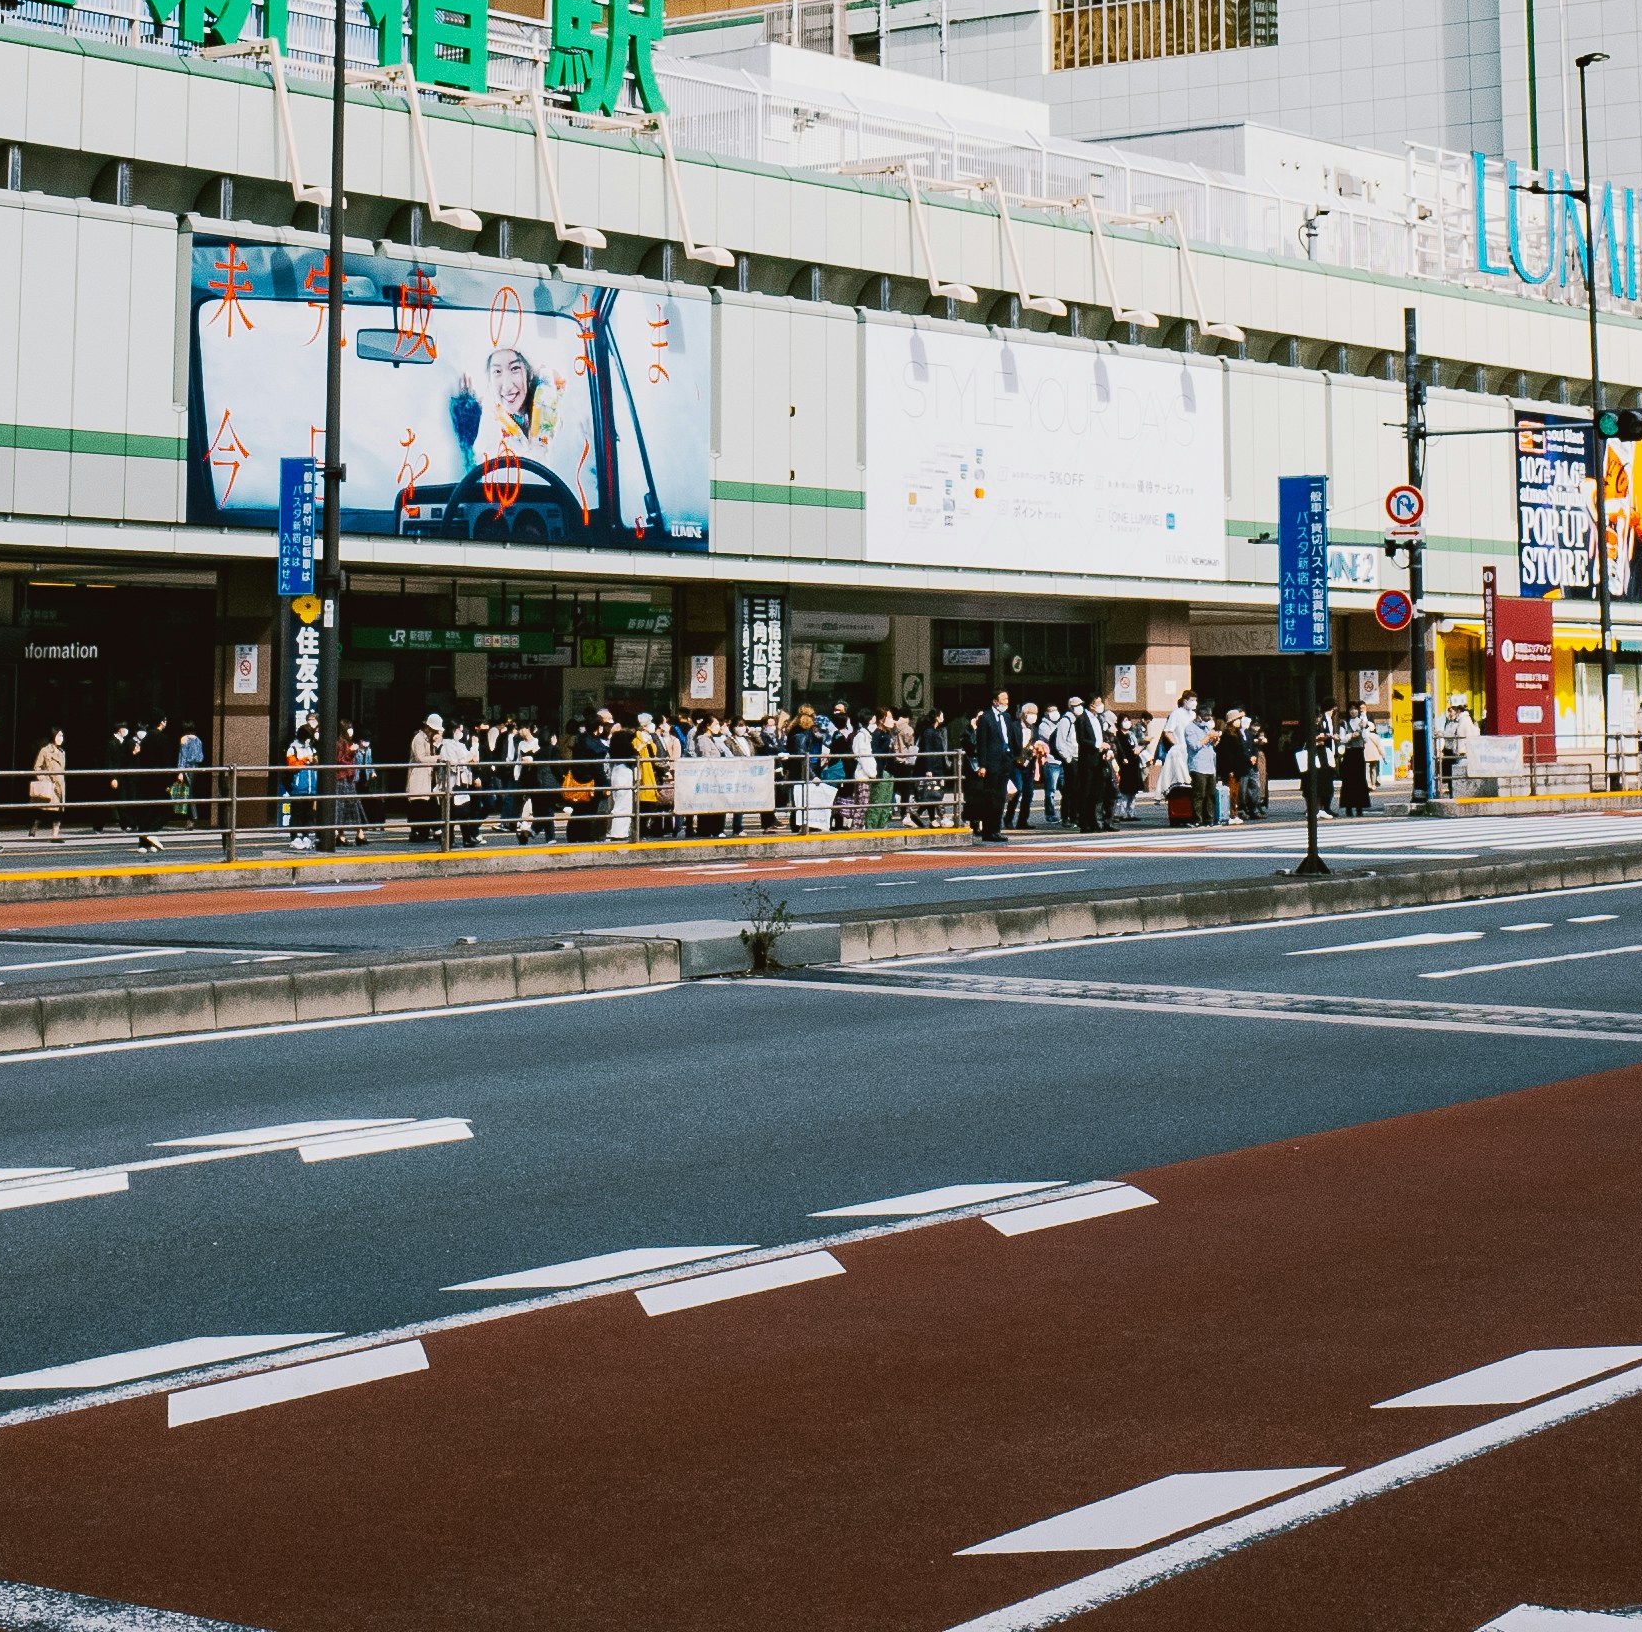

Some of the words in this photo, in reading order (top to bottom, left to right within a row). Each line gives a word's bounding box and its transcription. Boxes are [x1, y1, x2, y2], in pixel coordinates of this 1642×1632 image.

[902, 359, 1014, 429] STYLE
[1017, 376, 1109, 438] YOUR
[1116, 386, 1196, 447] DAYS
[281, 532, 291, 591] 入れません
[291, 485, 303, 567] バスタ新宿へは
[1296, 510, 1310, 617] バスタ新宿へは
[1519, 505, 1590, 548] POP-UP
[1521, 545, 1589, 588] STORE
[1283, 571, 1297, 646] 入れません
